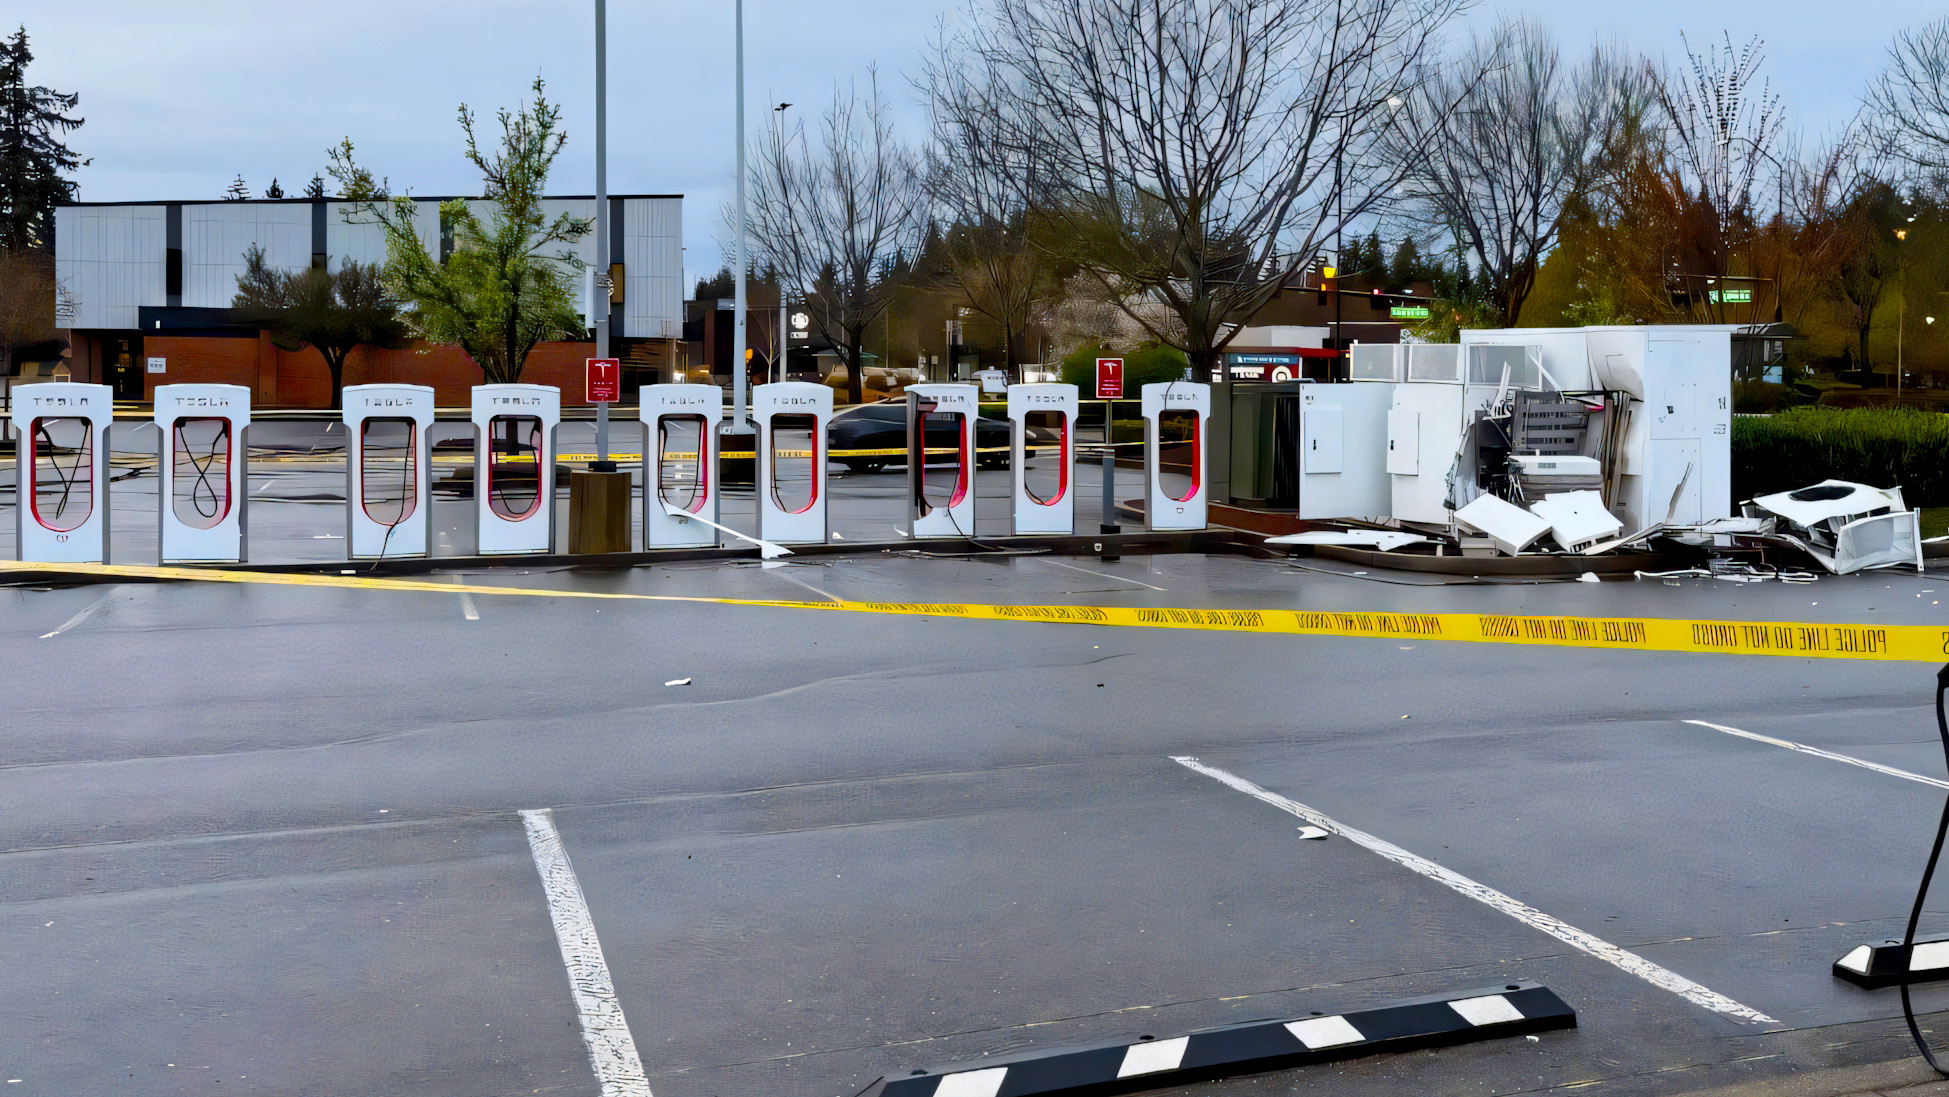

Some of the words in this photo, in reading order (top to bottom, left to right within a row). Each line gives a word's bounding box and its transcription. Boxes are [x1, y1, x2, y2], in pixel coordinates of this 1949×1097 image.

[33, 397, 88, 406] TESLA
[174, 397, 229, 406] TESLA
[492, 397, 540, 406] TESLA
